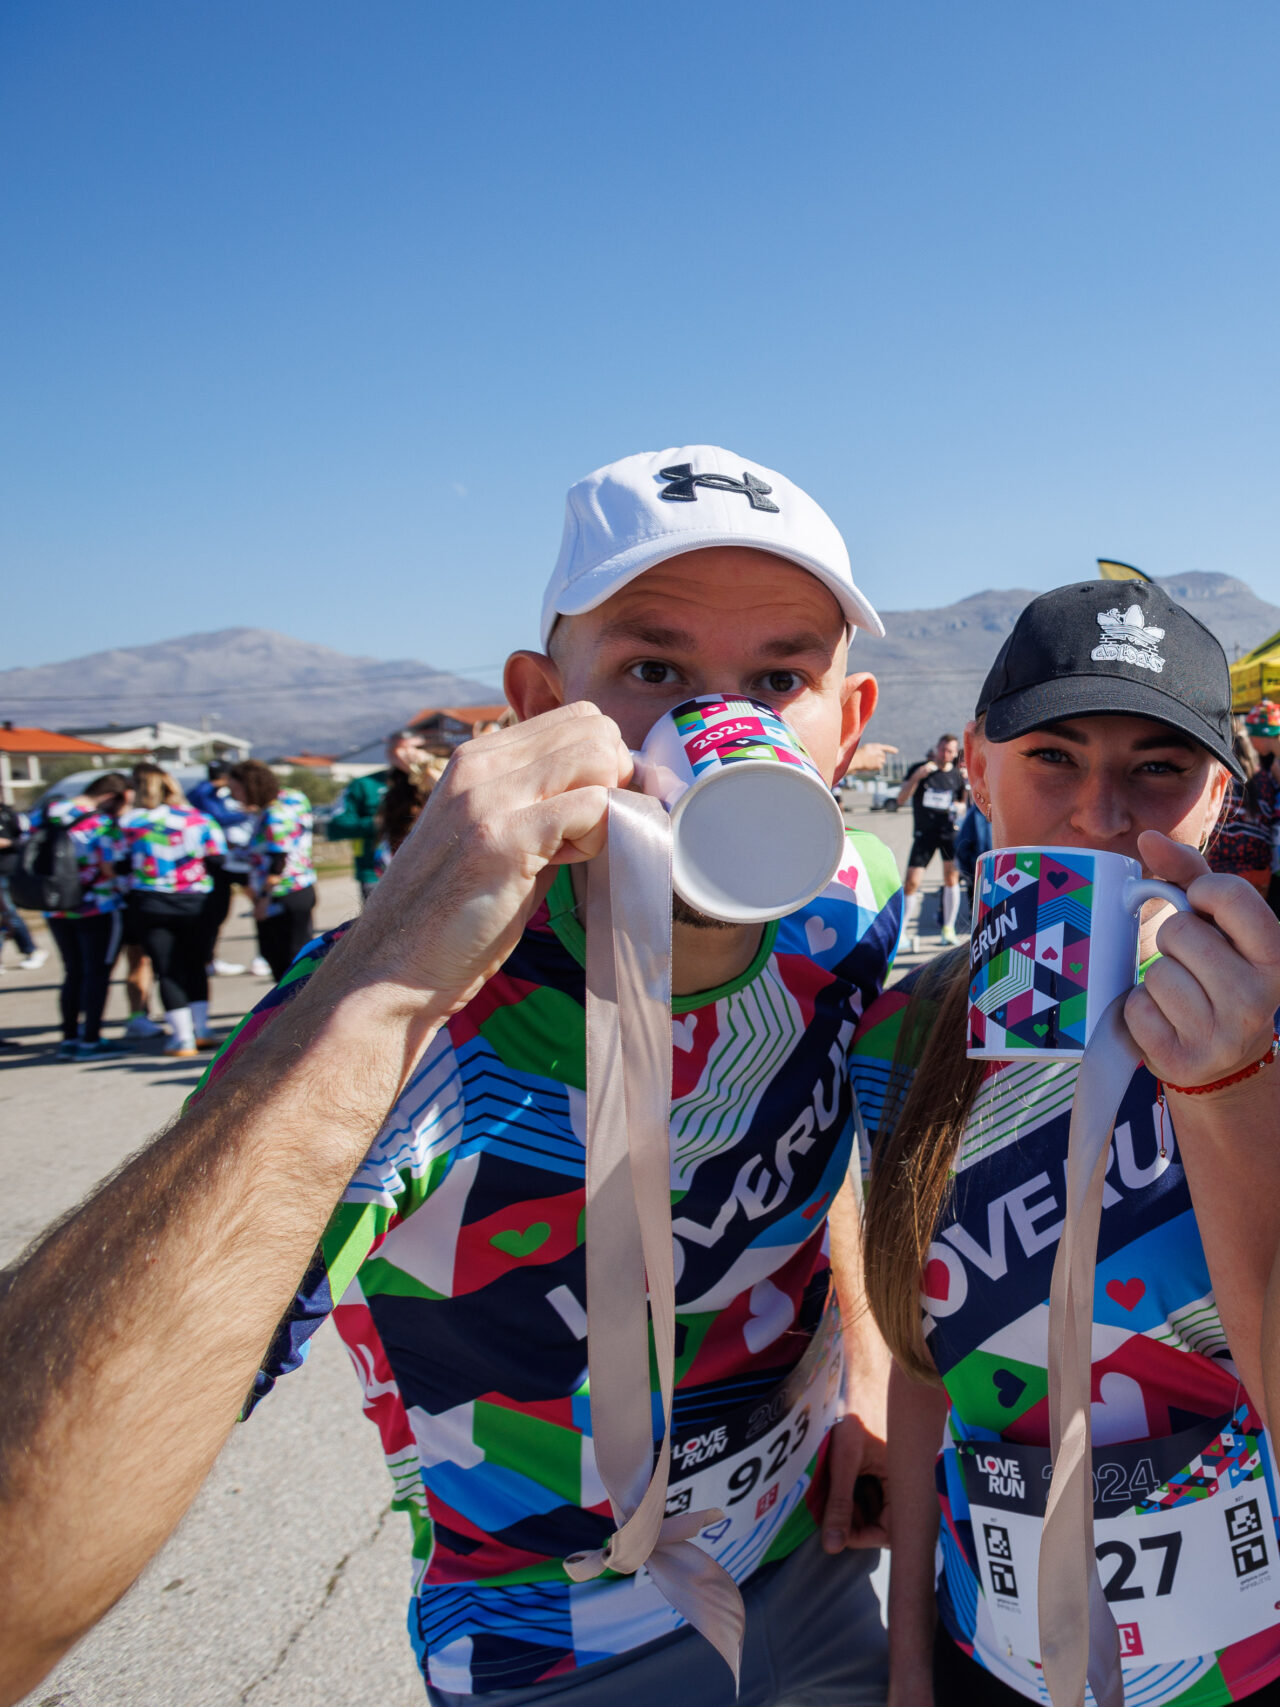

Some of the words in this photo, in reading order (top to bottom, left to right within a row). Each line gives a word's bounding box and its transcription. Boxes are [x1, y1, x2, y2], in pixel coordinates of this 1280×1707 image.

[692, 723, 753, 750] 2024
[970, 906, 1018, 971] ERUN
[671, 1424, 728, 1461] LOVE
[680, 1436, 730, 1471] RUN
[726, 1402, 812, 1507] 923
[975, 1453, 1022, 1480] LOVE
[988, 1475, 1026, 1500] RUN
[1094, 1530, 1183, 1603] 27
